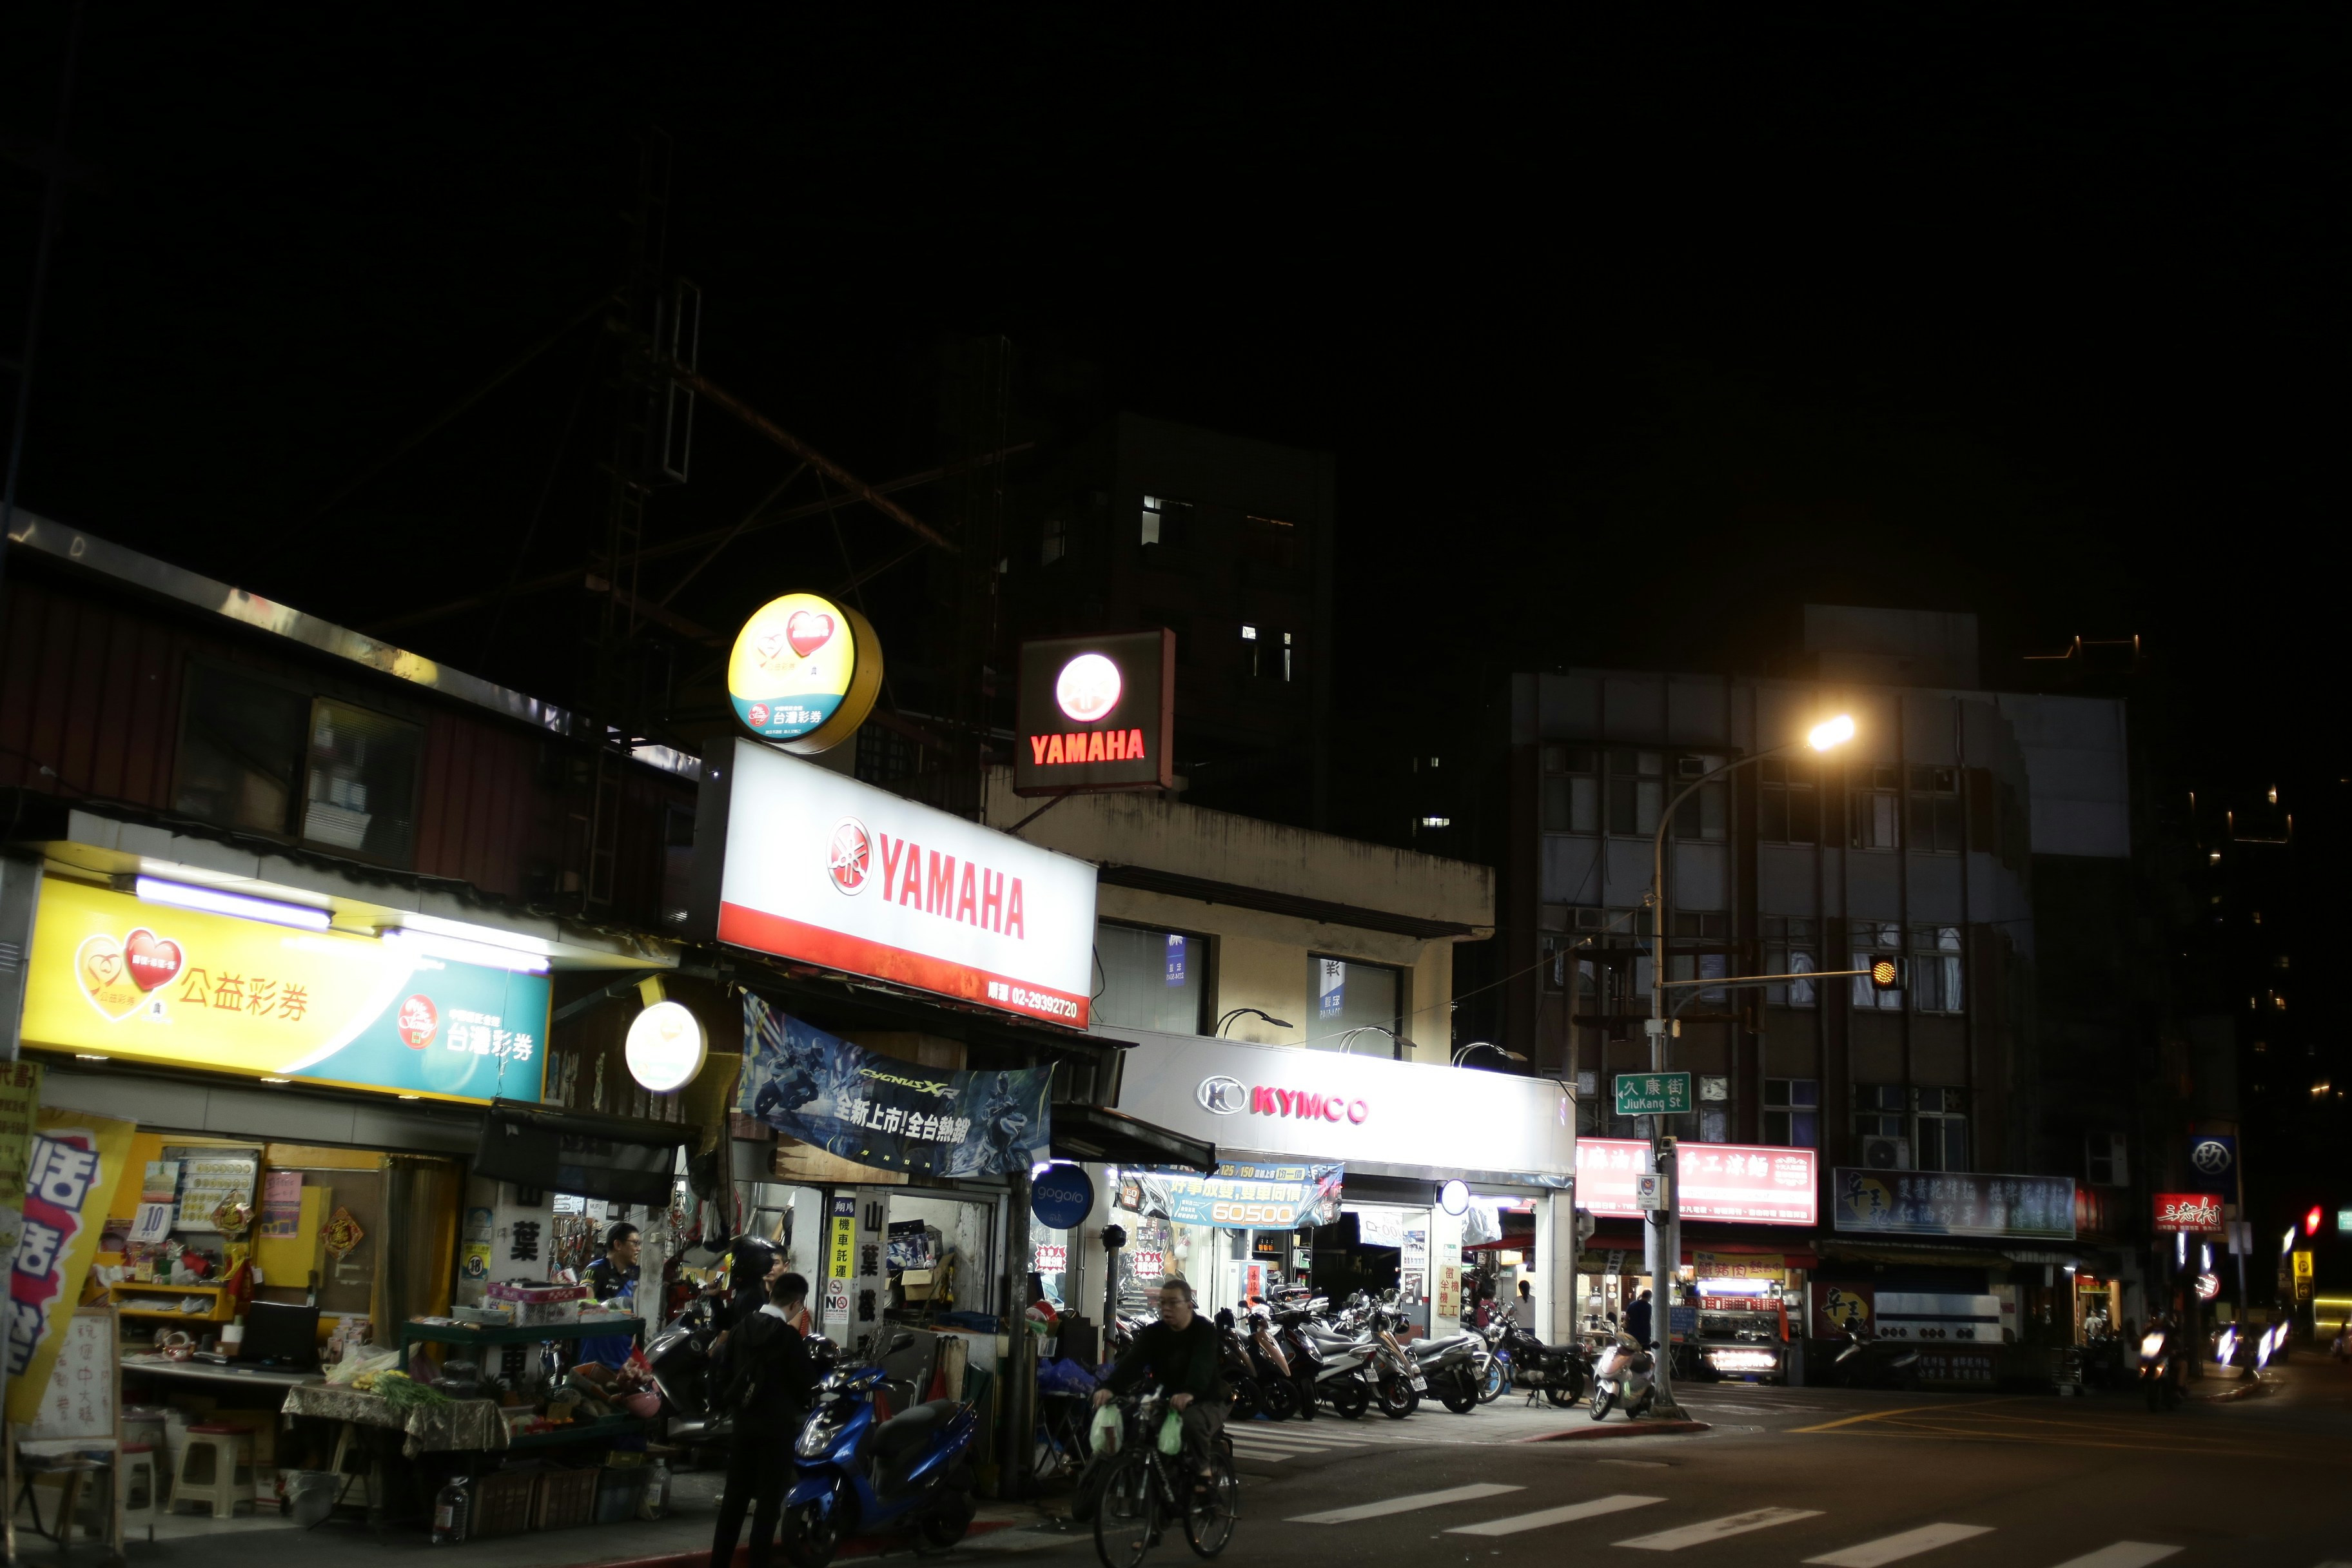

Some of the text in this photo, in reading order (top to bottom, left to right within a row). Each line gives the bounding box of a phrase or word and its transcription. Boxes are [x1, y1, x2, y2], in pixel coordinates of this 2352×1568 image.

[774, 711, 822, 724] 台灣彩券
[1031, 729, 1144, 765] YAMAHA
[879, 832, 1024, 940] YAMAHA
[100, 991, 136, 1006] 公益彩券
[180, 967, 308, 1021] 公益彩券
[1012, 987, 1077, 1018] 02-29392720
[447, 1022, 533, 1061] 台灣彩券
[1624, 1078, 1683, 1095] 久康街
[1251, 1086, 1369, 1124] KYMCO
[1624, 1097, 1683, 1111] JiuKang St.
[834, 1095, 971, 1143] 全新上市!全台熱銷
[1220, 1164, 1235, 1177] 125
[1240, 1166, 1254, 1178] 150
[2197, 1145, 2224, 1171] 玖
[1125, 1188, 1137, 1197] 150
[142, 1206, 163, 1231] 10
[1213, 1202, 1292, 1223] 60,500
[834, 1218, 850, 1278] 機車託運
